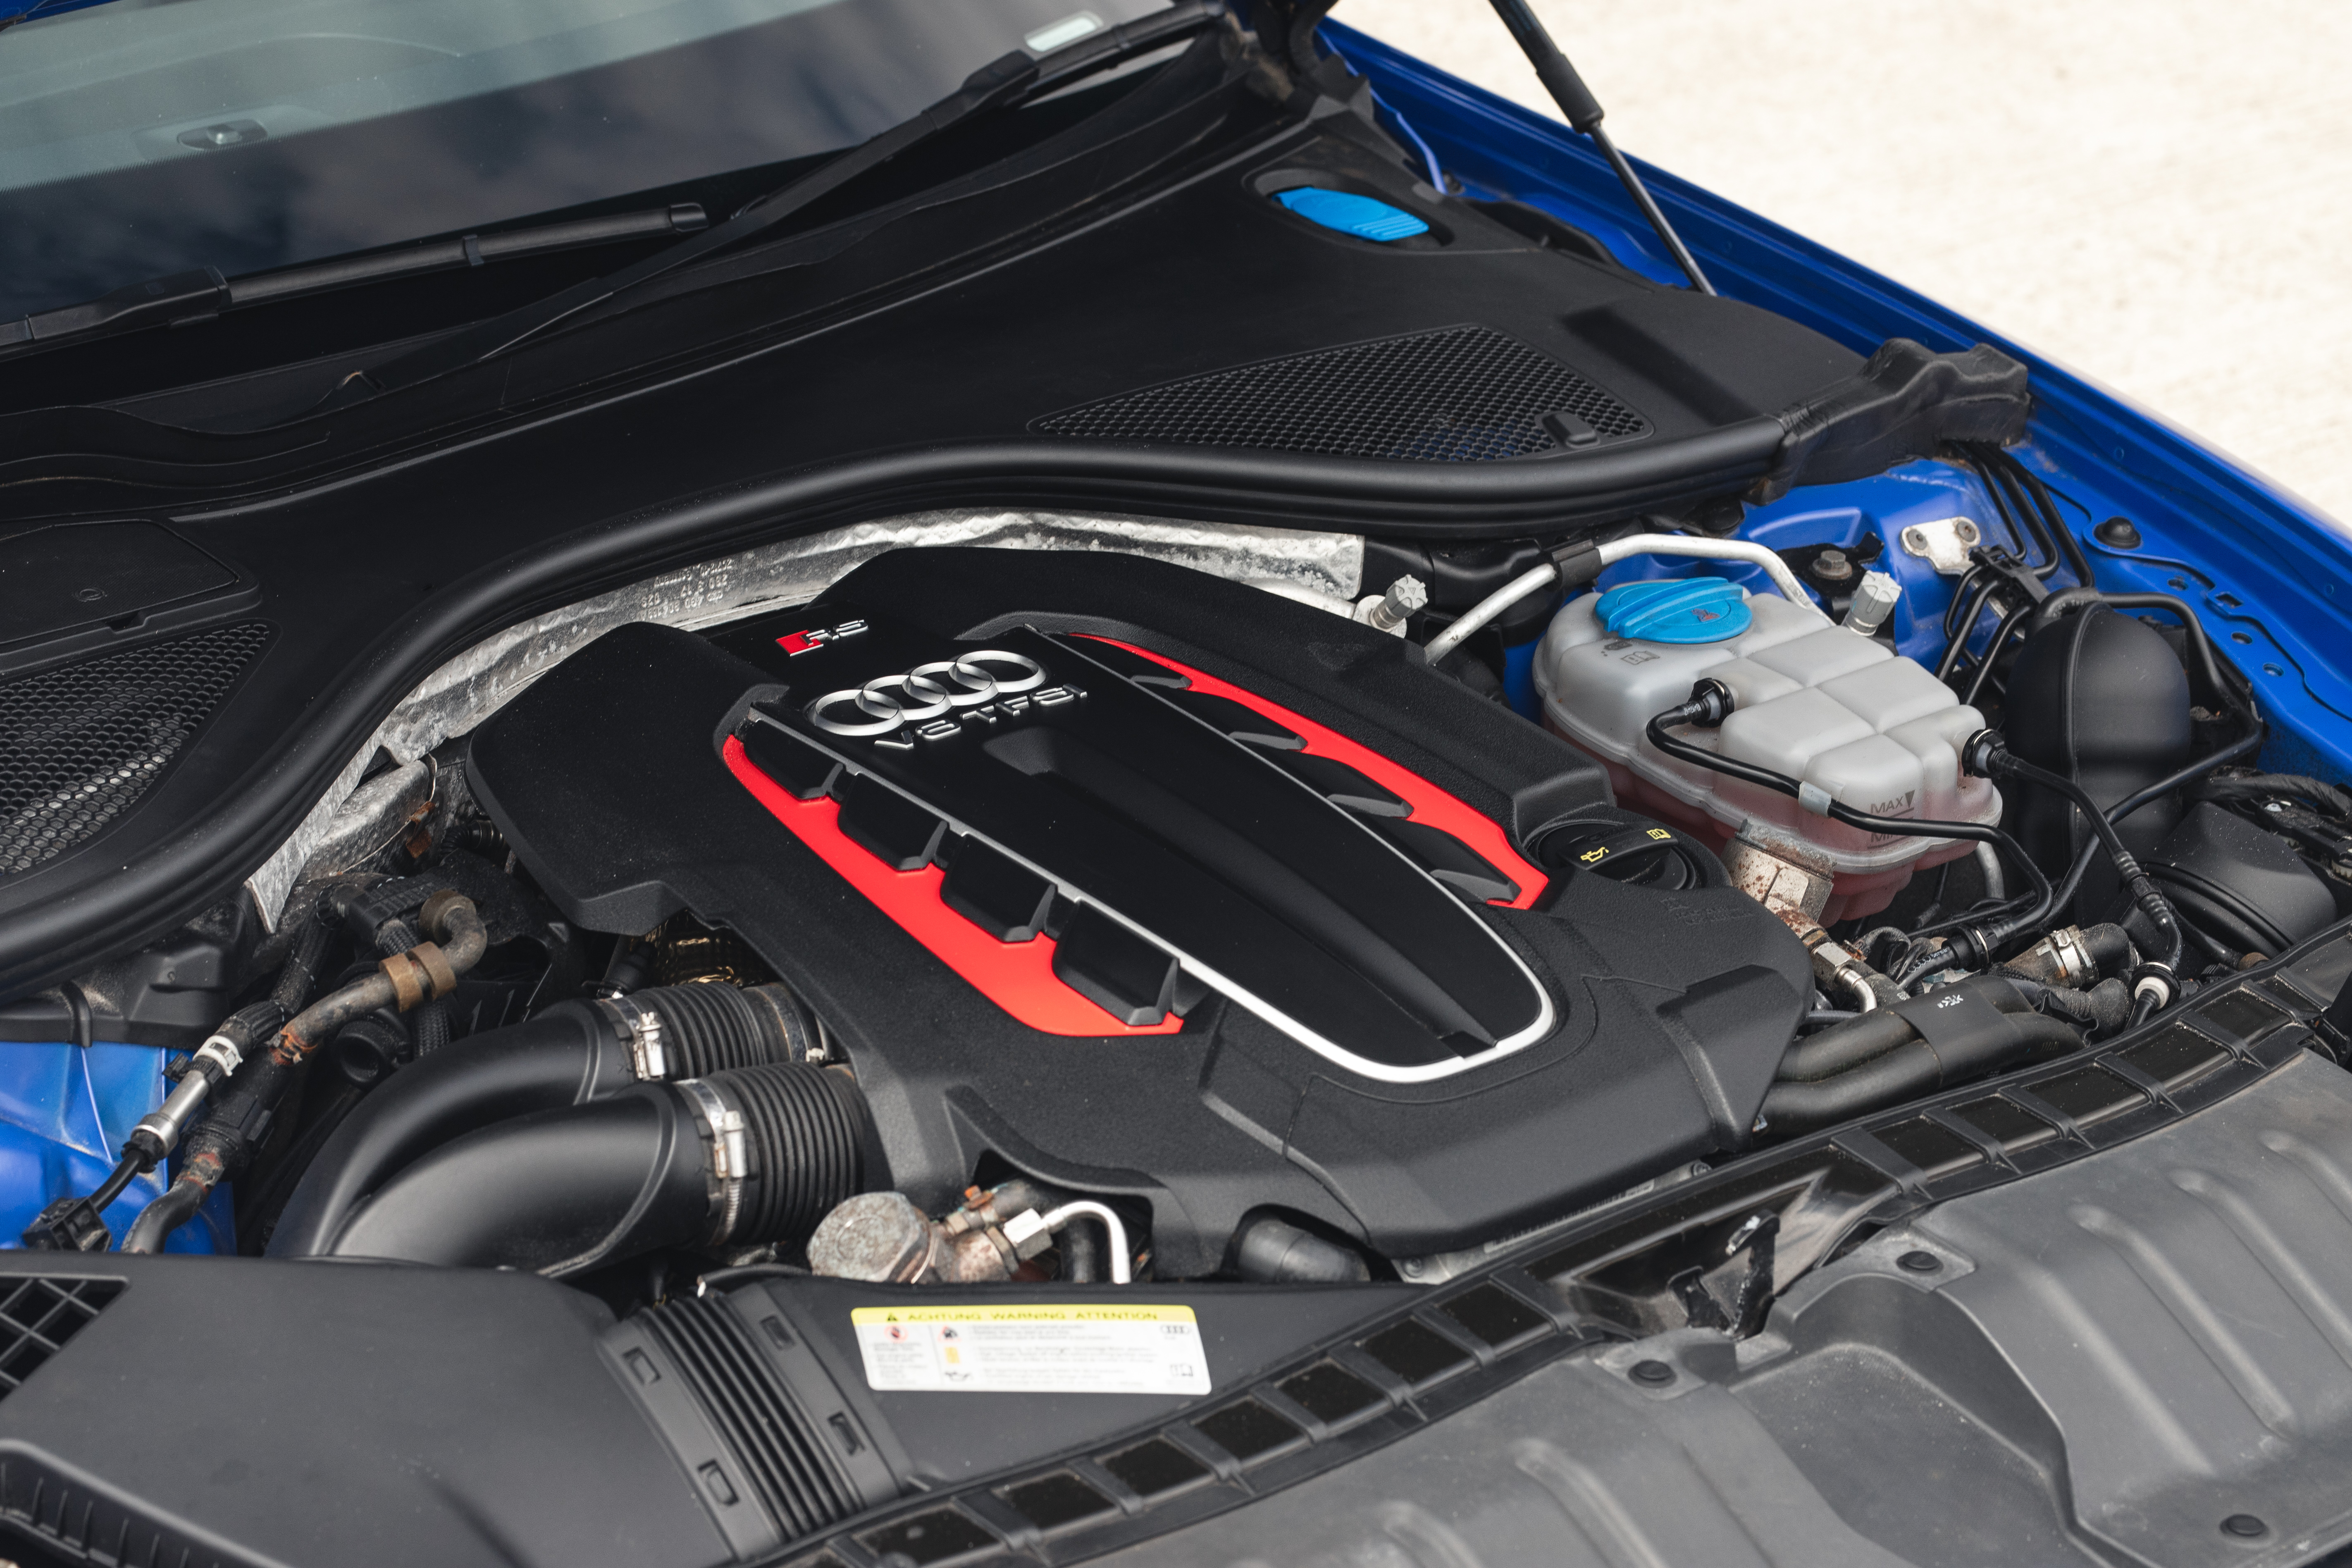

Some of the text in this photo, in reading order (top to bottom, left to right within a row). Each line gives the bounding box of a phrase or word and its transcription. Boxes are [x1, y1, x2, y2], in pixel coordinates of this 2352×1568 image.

[800, 619, 870, 645] RS
[874, 683, 1088, 750] V8 TFSI
[1870, 796, 1904, 814] MAX
[908, 1311, 1159, 1322] ACHTUNG WARNING ATTENTION
